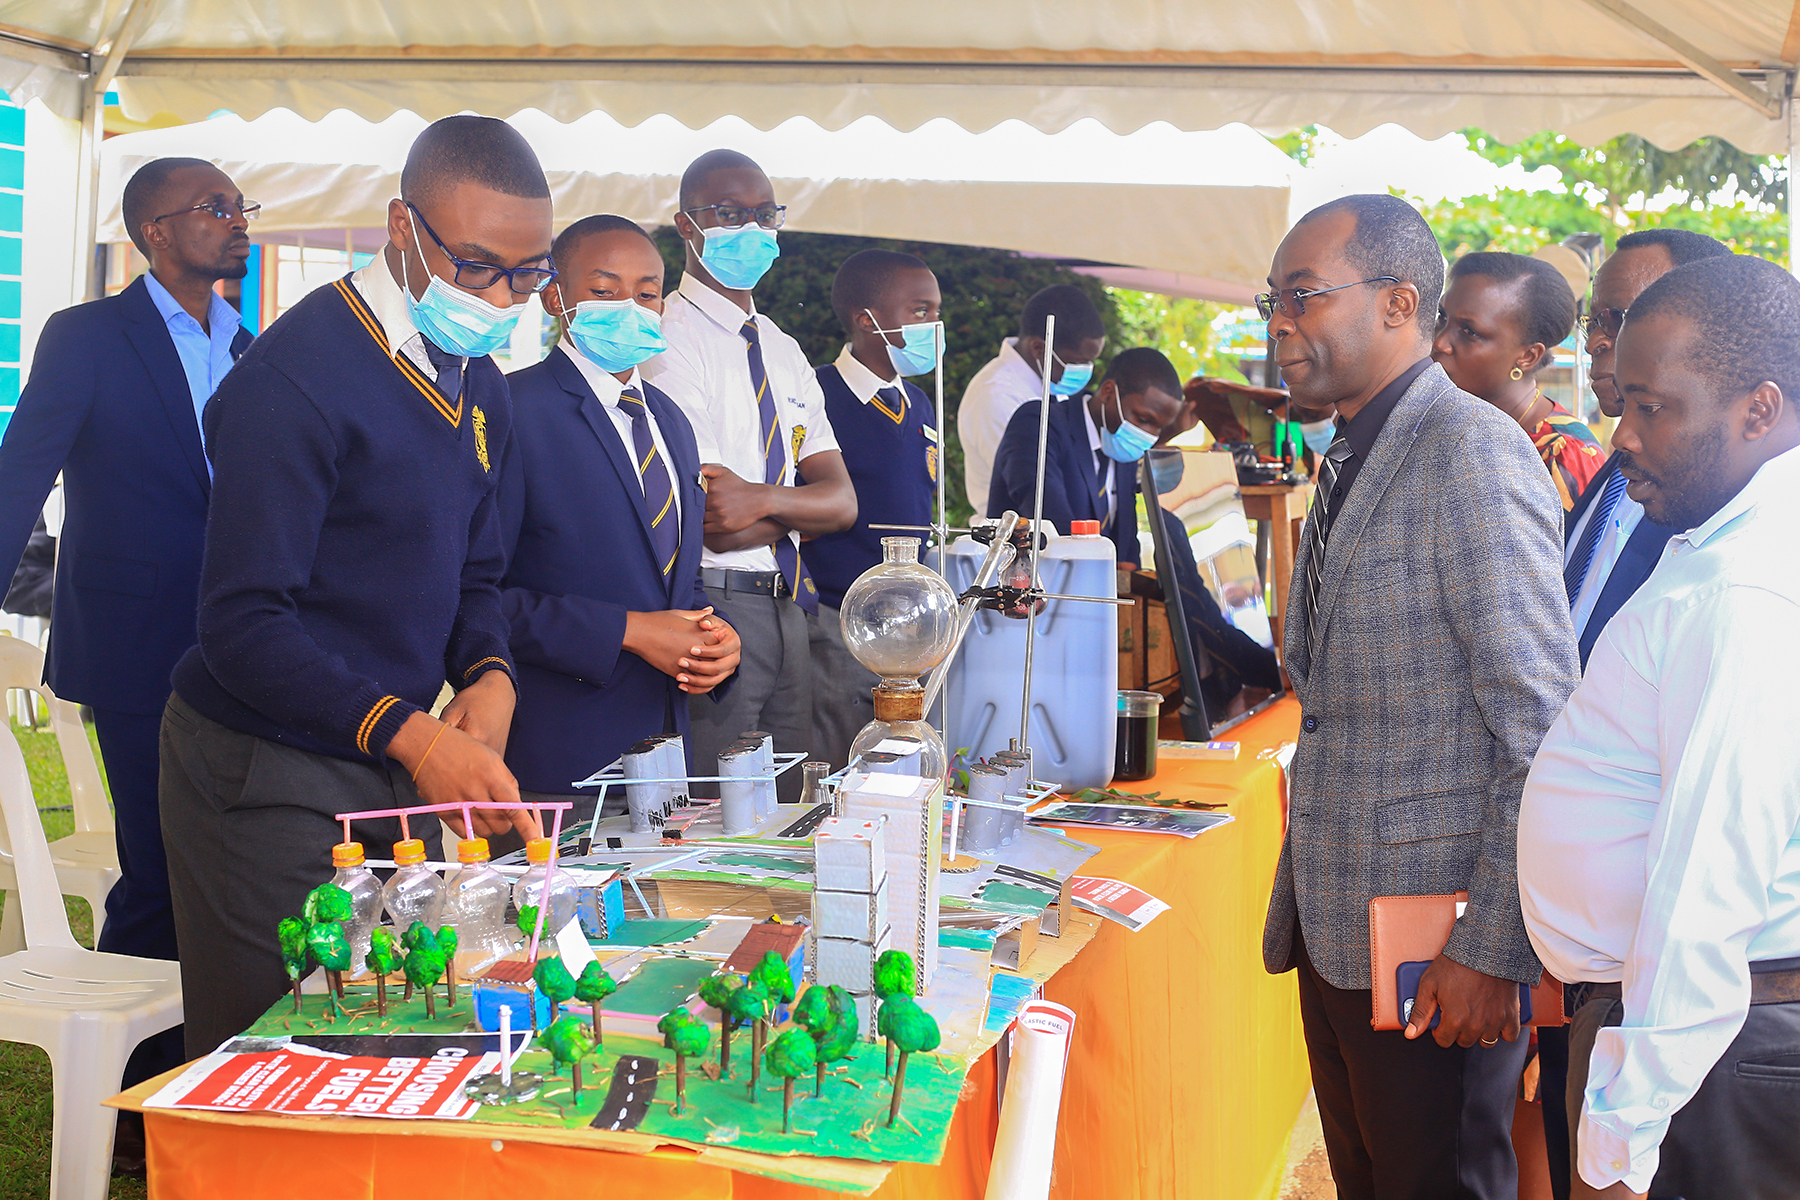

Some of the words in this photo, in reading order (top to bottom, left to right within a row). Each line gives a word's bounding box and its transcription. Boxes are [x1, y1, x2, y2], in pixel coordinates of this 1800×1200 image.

[1048, 1021, 1063, 1030] FUEL
[304, 1068, 372, 1110] FUELS
[345, 1057, 420, 1112] BETTER
[386, 1047, 469, 1114] CHOOSING
